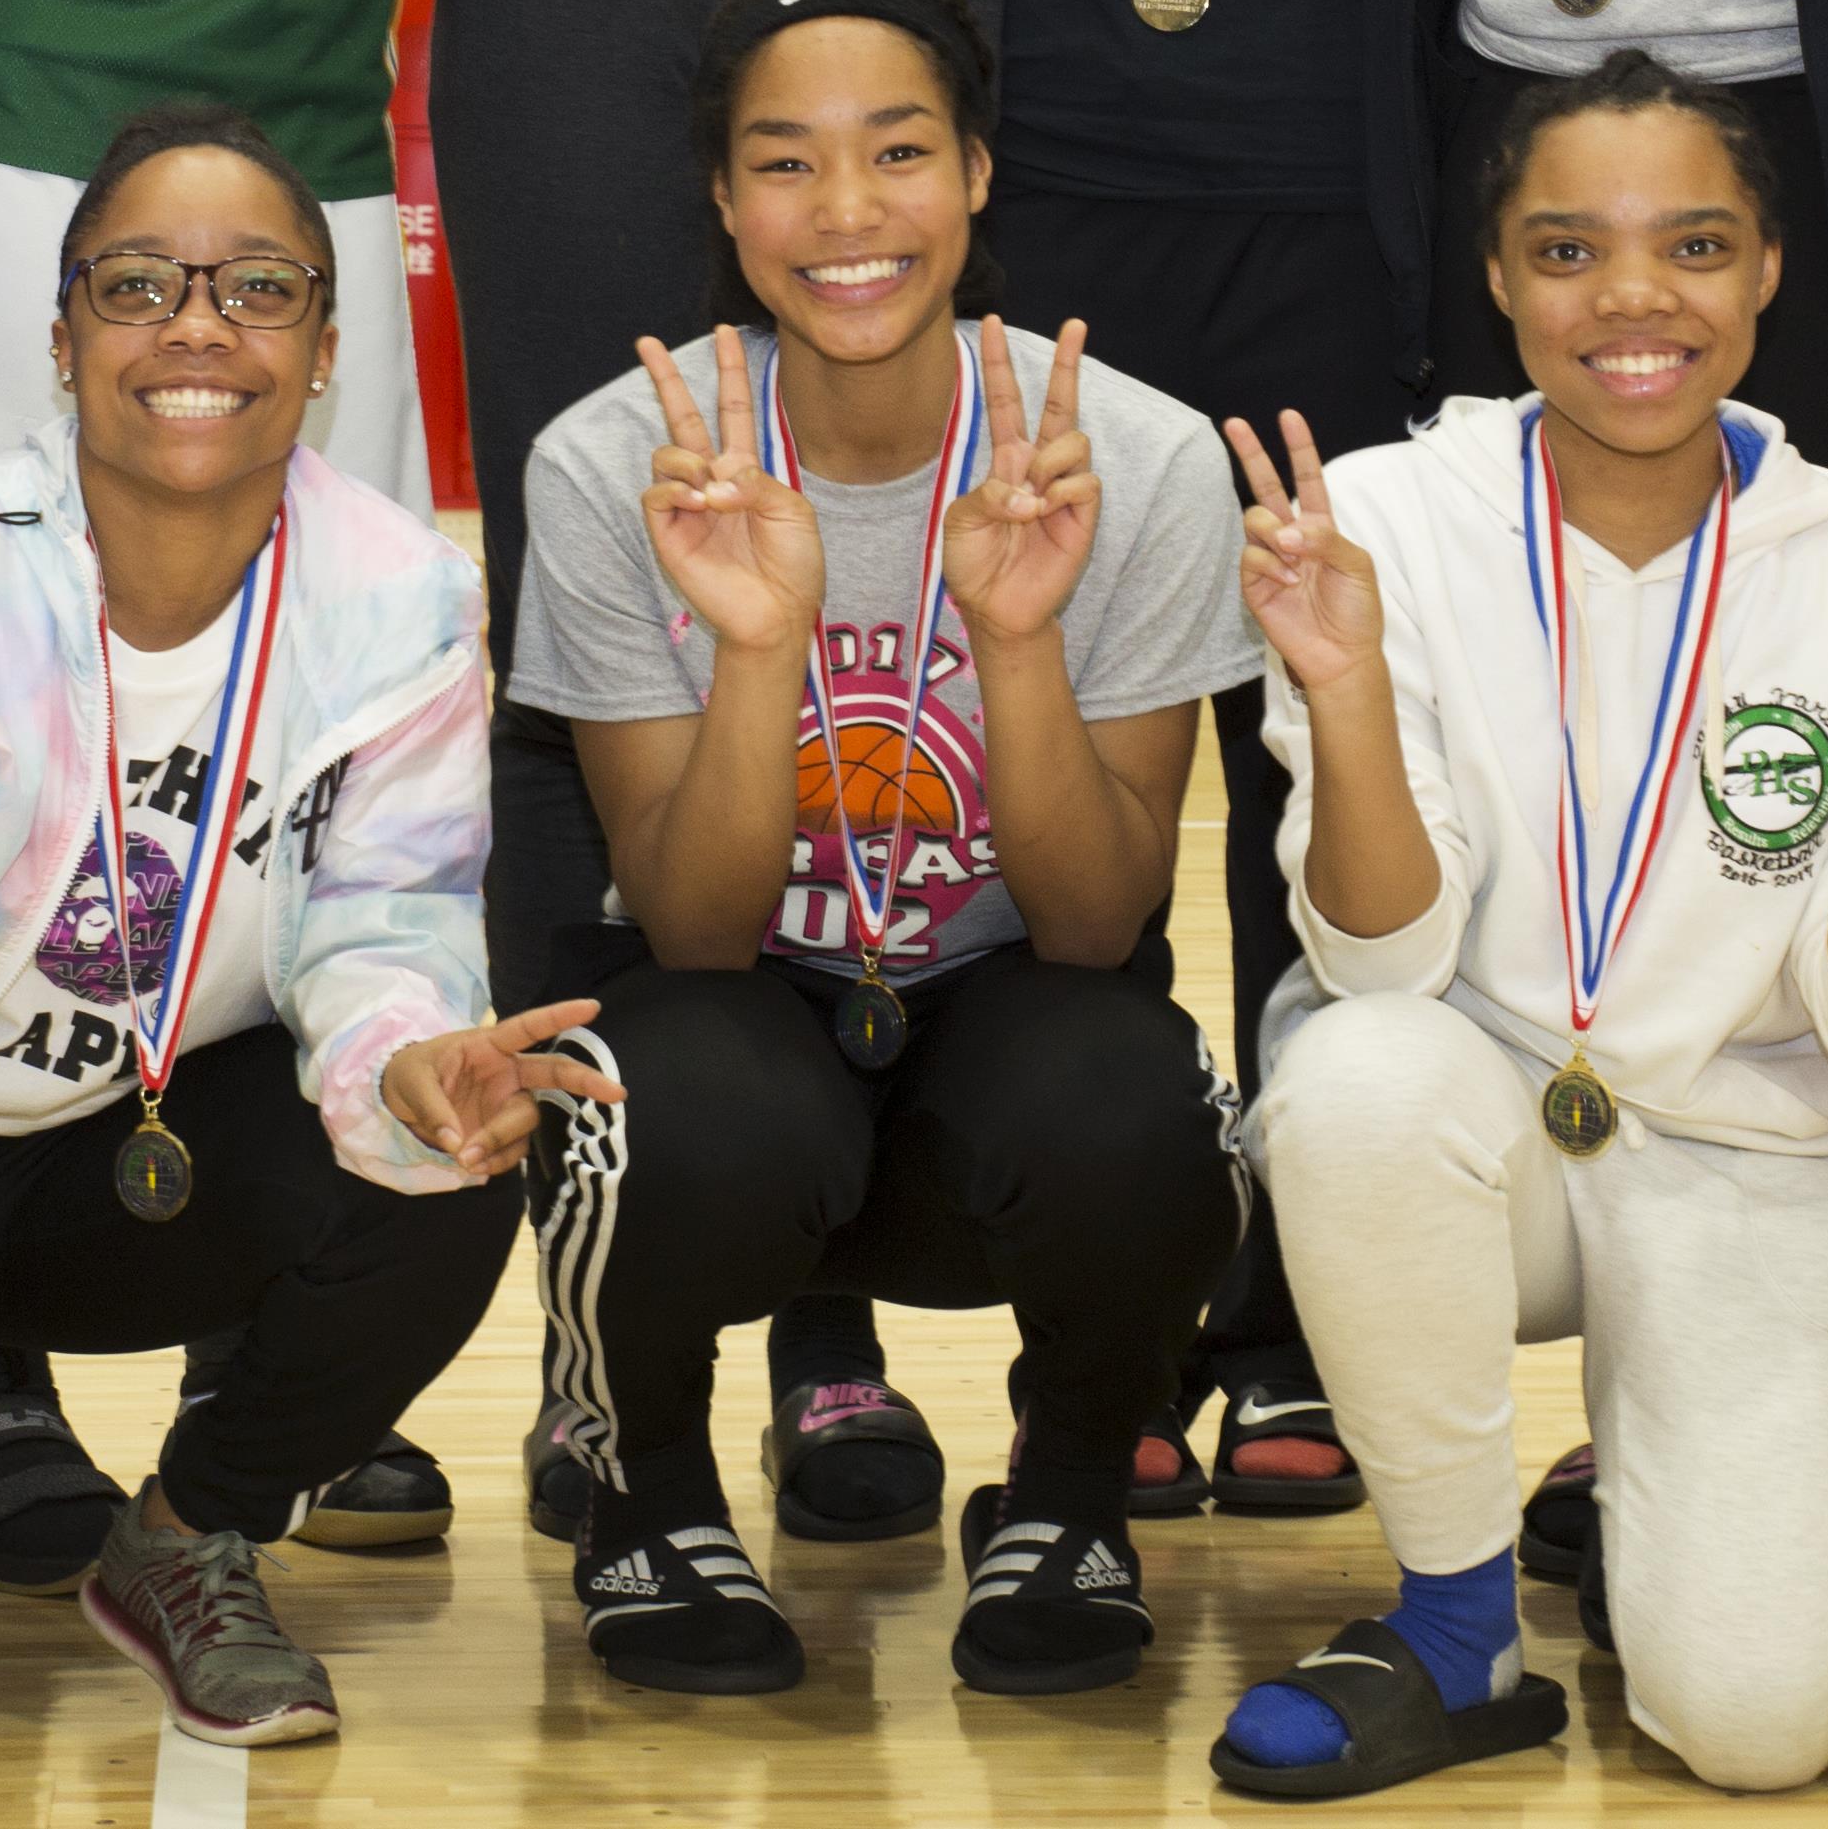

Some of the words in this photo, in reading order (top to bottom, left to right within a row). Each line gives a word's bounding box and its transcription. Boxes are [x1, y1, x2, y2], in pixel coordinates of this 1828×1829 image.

[782, 878, 934, 956] D2
[811, 1383, 888, 1412] NIKE
[590, 1575, 661, 1596] adidas
[1074, 1569, 1132, 1590] adidas
